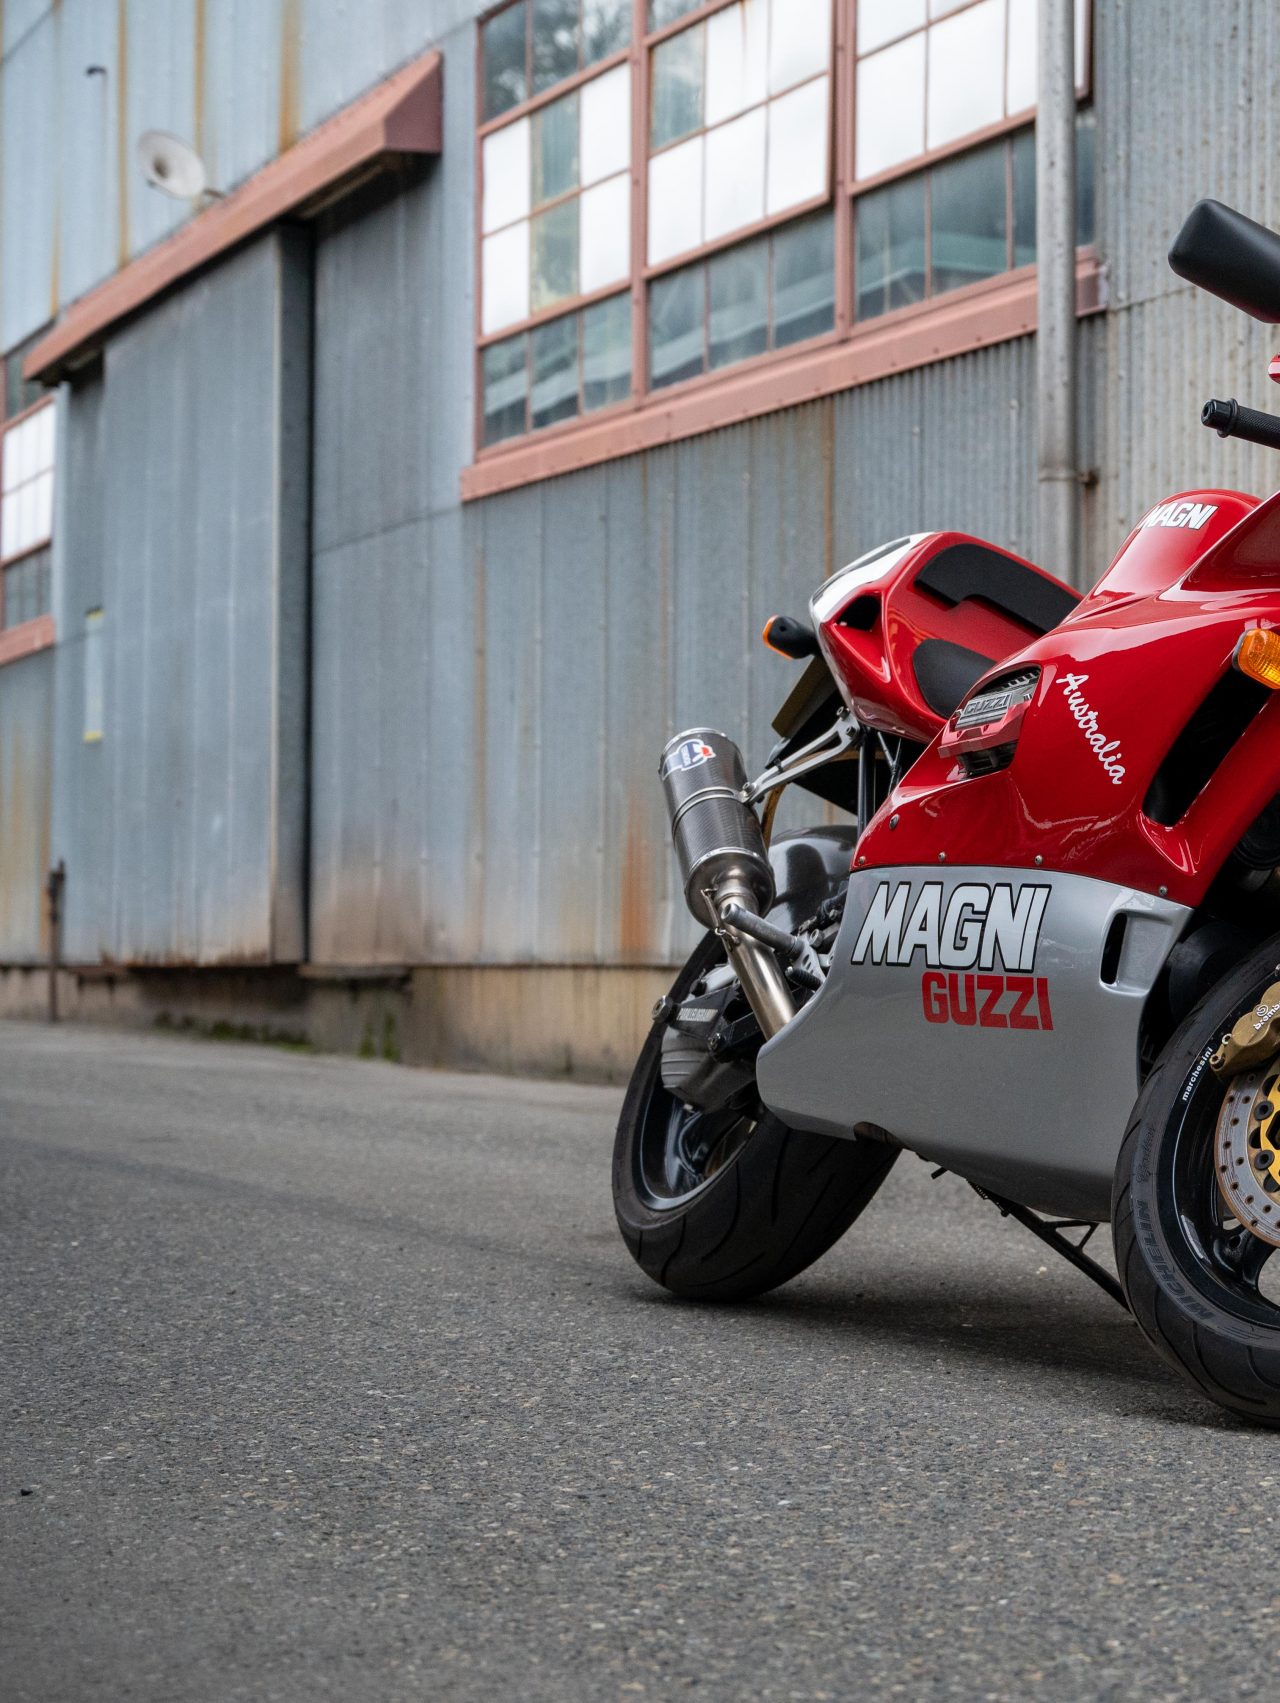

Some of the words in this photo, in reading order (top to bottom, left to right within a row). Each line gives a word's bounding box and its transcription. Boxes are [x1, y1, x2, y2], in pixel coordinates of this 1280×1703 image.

[965, 694, 1010, 715] GUZZI
[1056, 673, 1126, 785] Australia
[850, 881, 1052, 973] MAGNI
[921, 971, 1054, 1031] GUZZI
[1182, 1046, 1214, 1101] marchesini
[1136, 1199, 1216, 1323] MICHELIN
